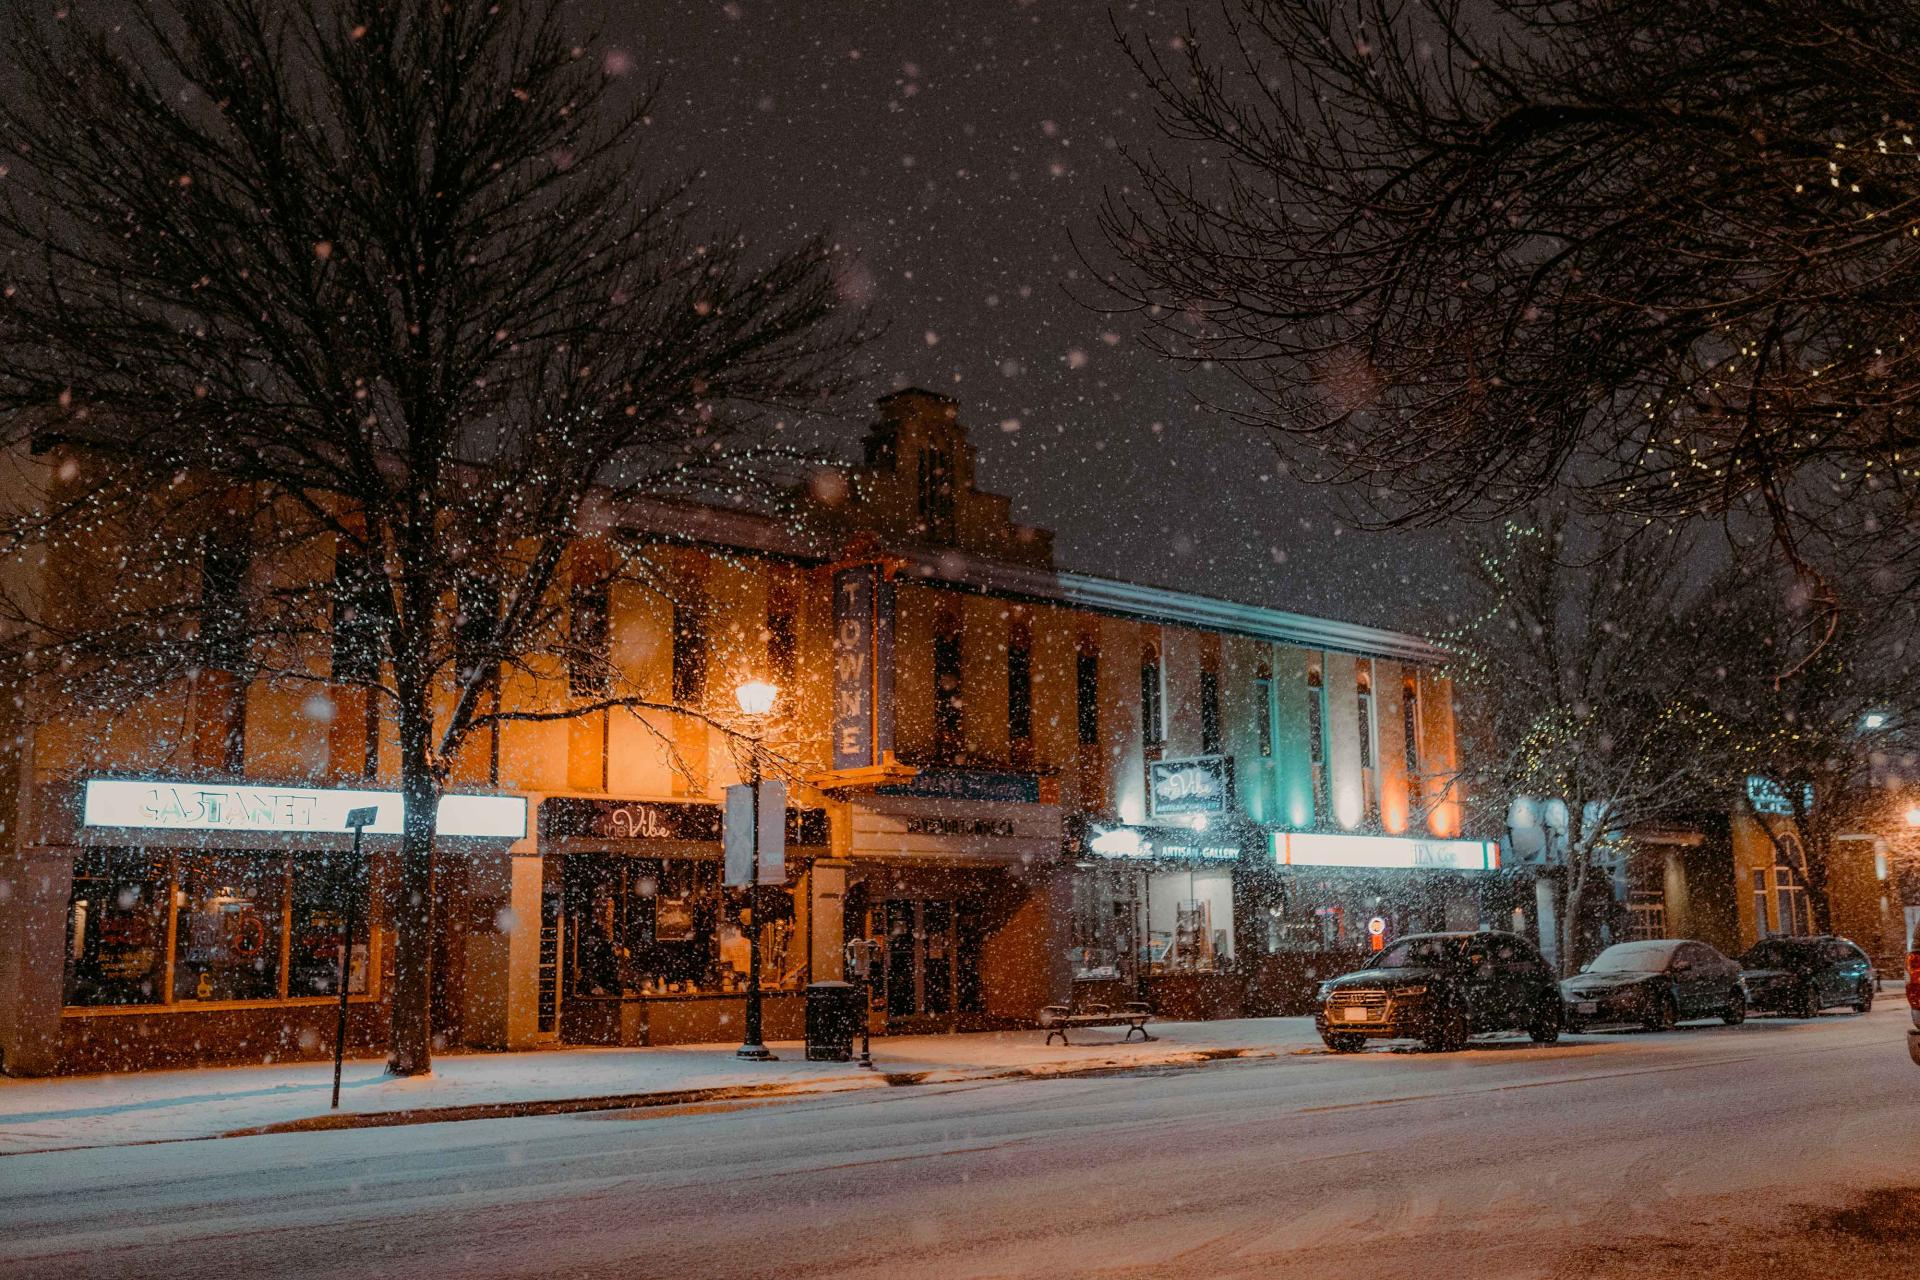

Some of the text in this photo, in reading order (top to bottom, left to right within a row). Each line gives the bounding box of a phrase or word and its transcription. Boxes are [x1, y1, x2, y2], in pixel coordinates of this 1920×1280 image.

[838, 582, 865, 755] TOWNE
[613, 805, 670, 837] Vibe
[1162, 845, 1240, 859] ARTISAN GALLERY
